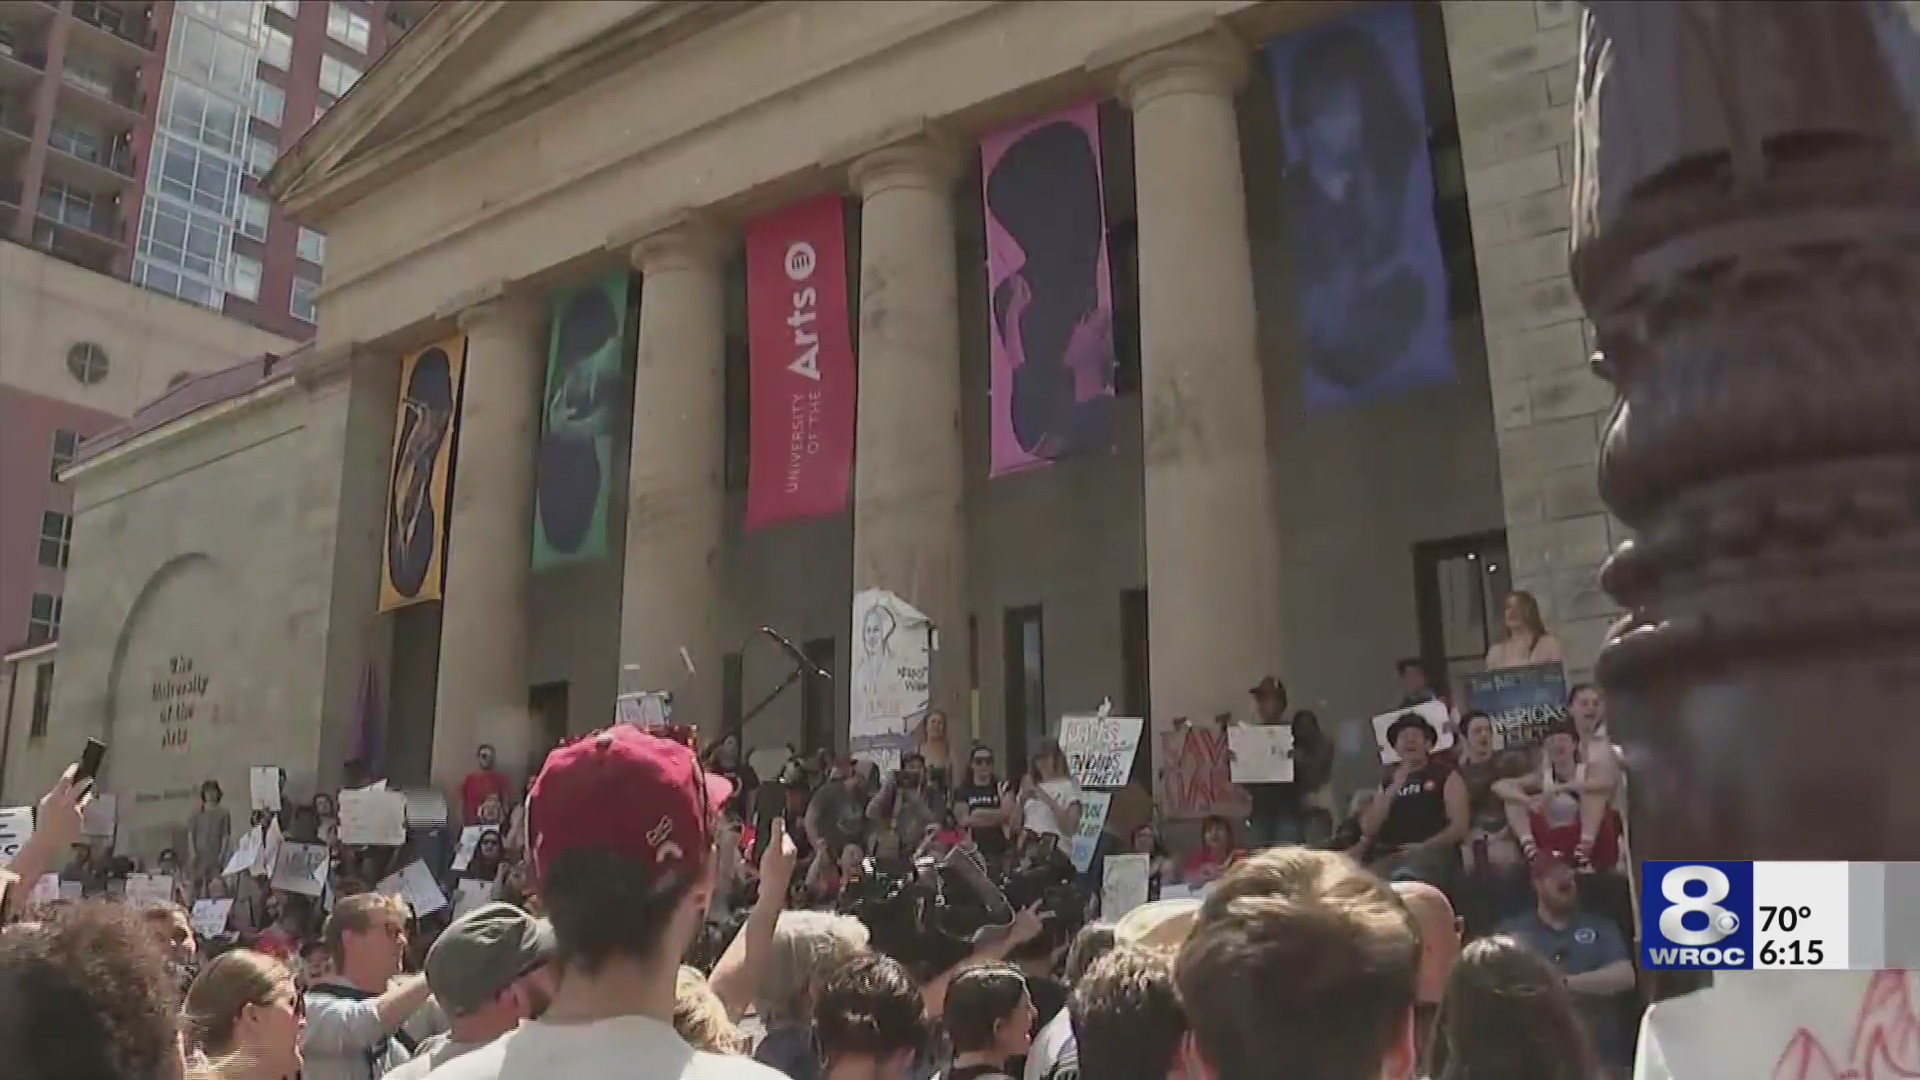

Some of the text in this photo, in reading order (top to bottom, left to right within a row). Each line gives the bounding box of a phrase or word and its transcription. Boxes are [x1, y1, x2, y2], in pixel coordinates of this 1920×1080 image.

[787, 286, 823, 381] Arts
[785, 394, 805, 494] UNIVERSITY
[807, 391, 822, 455] OF THE
